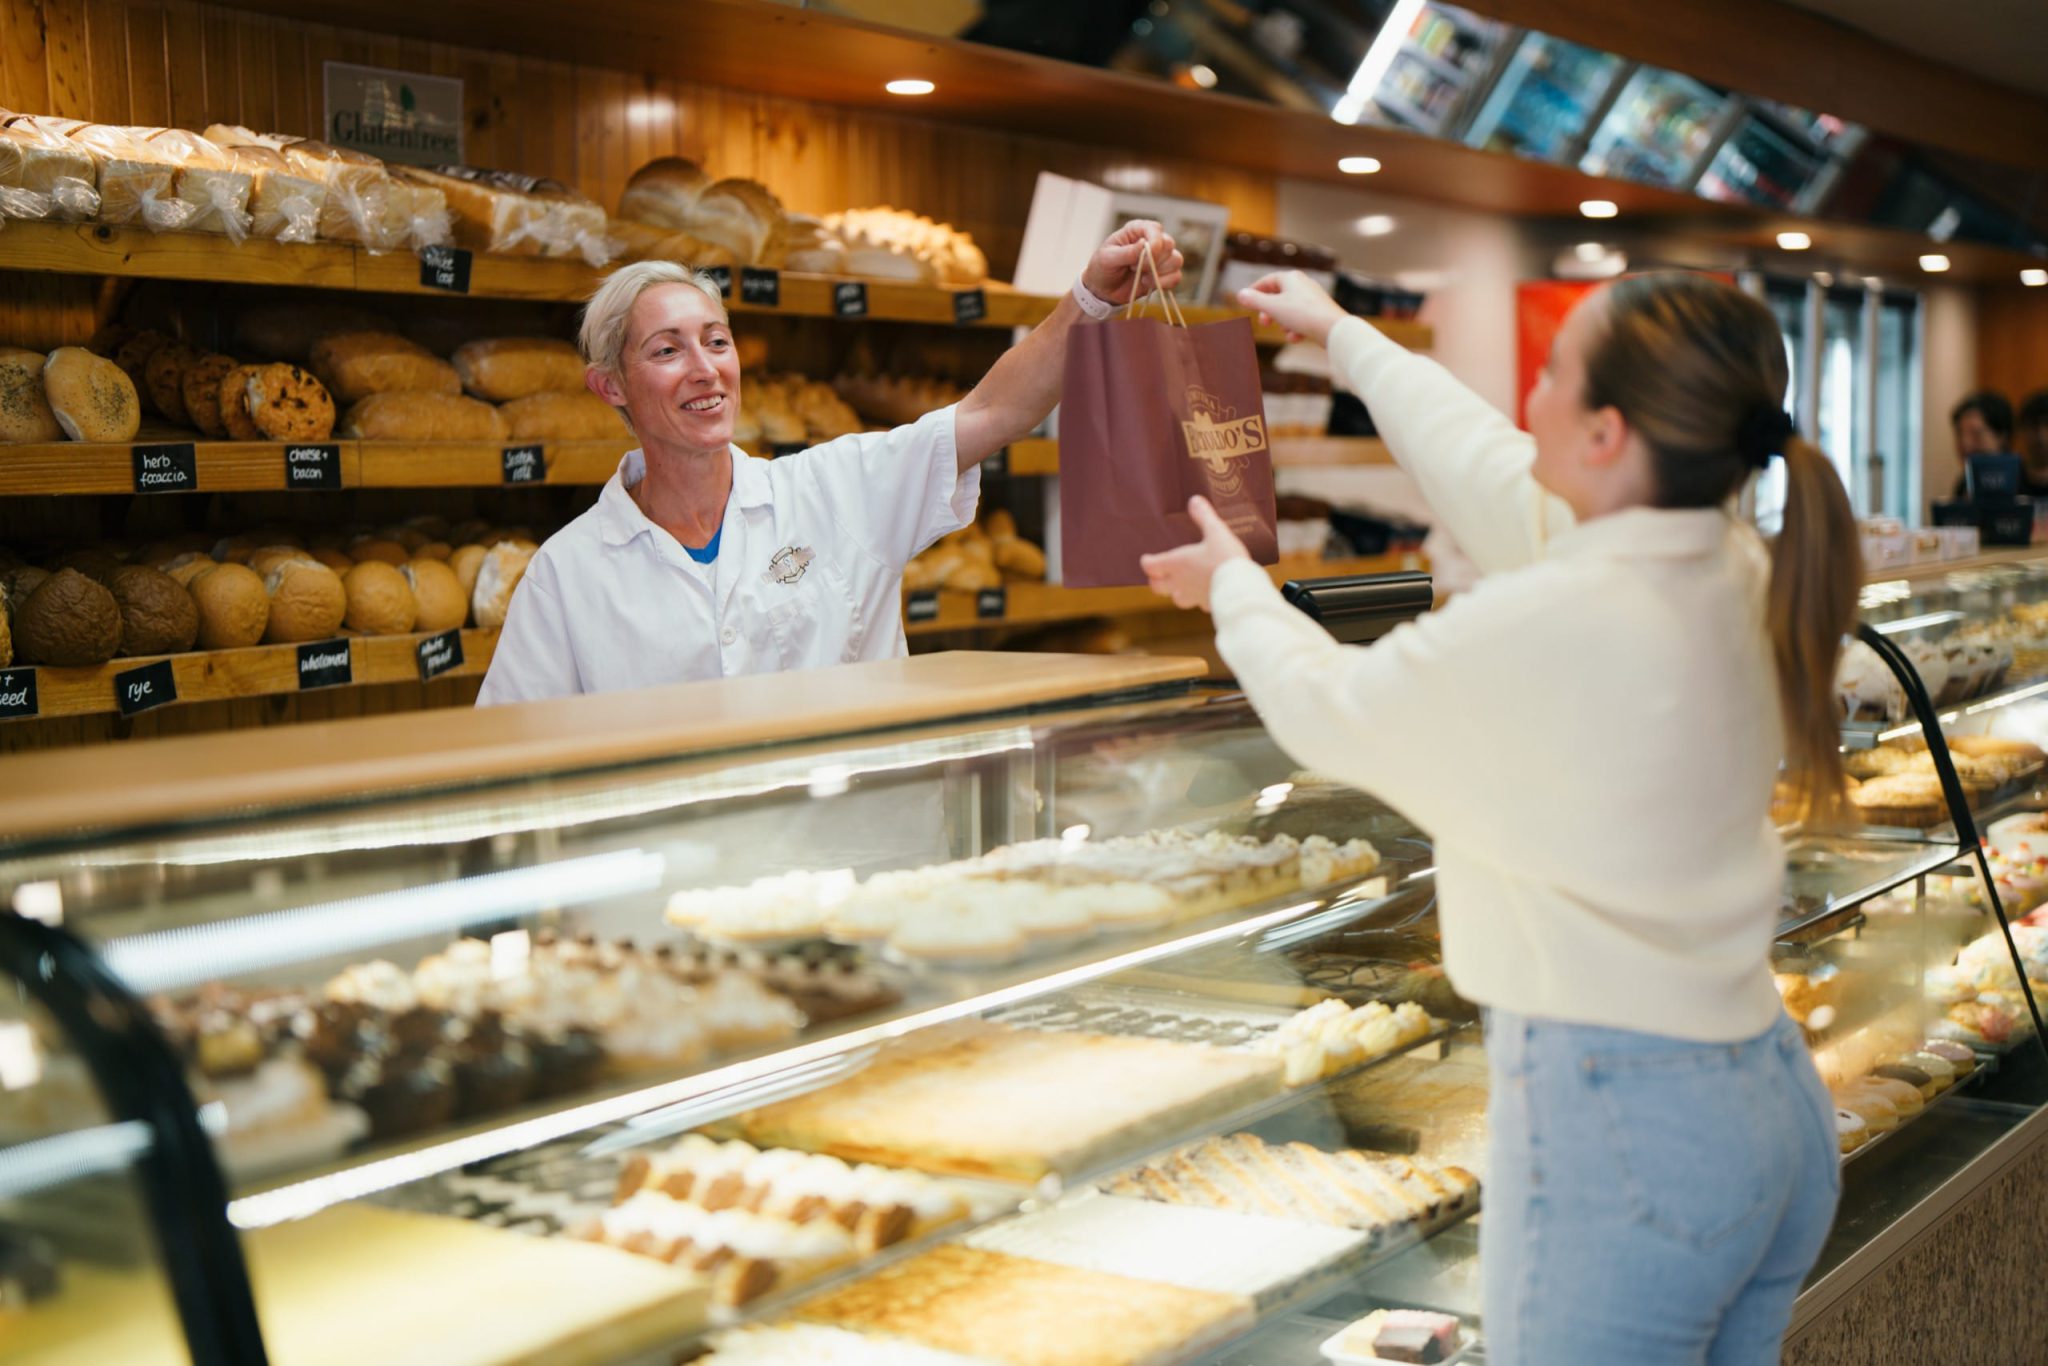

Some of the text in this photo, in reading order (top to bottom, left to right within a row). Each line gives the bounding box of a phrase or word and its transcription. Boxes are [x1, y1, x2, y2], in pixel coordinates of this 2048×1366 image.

[143, 454, 171, 469] herb
[289, 447, 321, 462] cheese
[140, 466, 188, 488] focaccia
[293, 465, 322, 480] bacon
[0, 687, 28, 706] eed
[128, 680, 153, 702] rye
